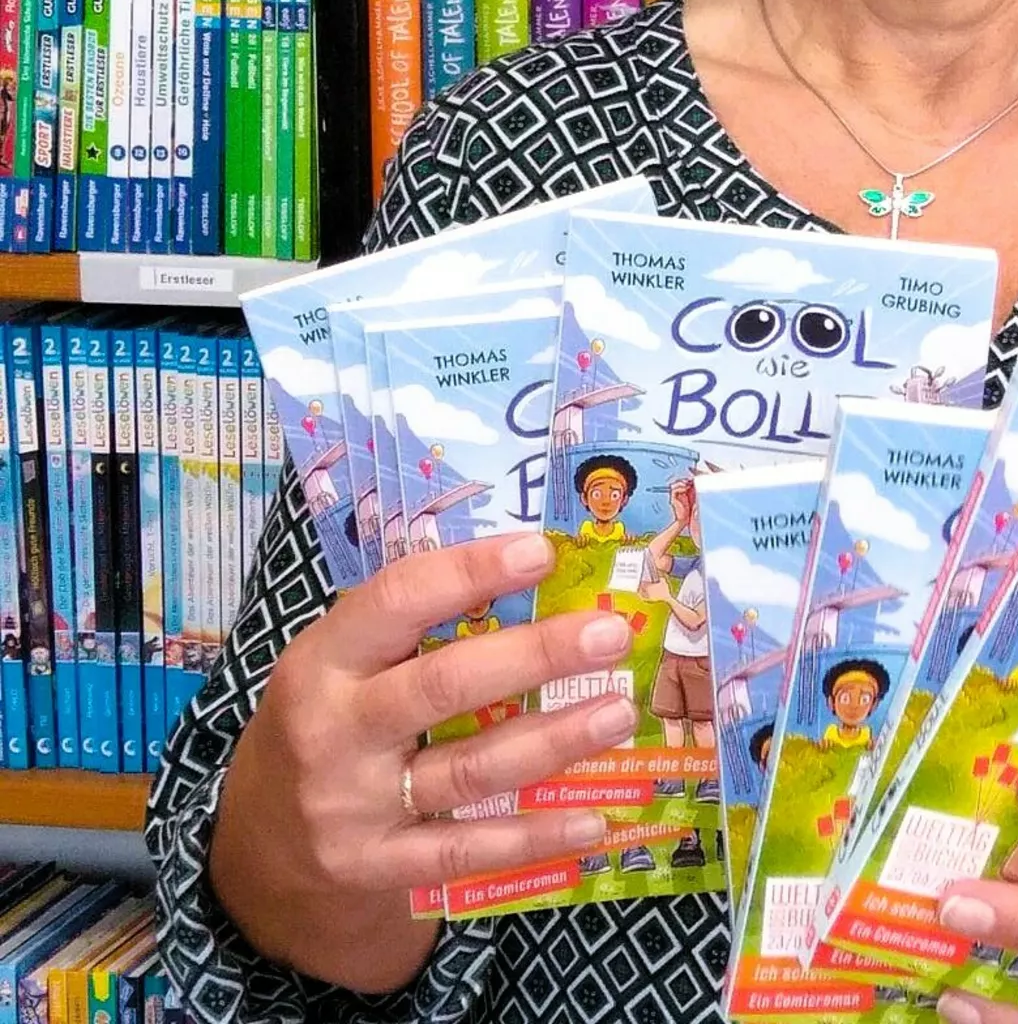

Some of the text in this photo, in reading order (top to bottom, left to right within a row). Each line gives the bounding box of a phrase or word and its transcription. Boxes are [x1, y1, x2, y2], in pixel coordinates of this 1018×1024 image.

[155, 2, 171, 107] Umweltschutz
[177, 19, 191, 106] Gefährliche
[389, 50, 410, 71] OF
[441, 52, 464, 74] OF
[113, 52, 125, 107] Ozeane
[134, 35, 147, 107] Haustiere
[36, 36, 52, 166] SPORT ERSTLESER
[62, 32, 76, 168] HAUSTIERE ERSTLESER
[34, 183, 47, 242] Ravensburger
[59, 179, 72, 238] Ravensburger
[85, 179, 97, 238] Ravensburger
[110, 183, 122, 244] Ravensburger
[612, 252, 685, 271] THOMAS
[160, 274, 215, 286] Erstleser
[611, 272, 685, 291] WINKLER
[899, 276, 943, 296] TIMO
[881, 293, 961, 319] GRUBING
[12, 338, 28, 355] 2
[671, 297, 898, 371] COOL
[222, 350, 236, 366] 2
[434, 348, 508, 371] THOMAS
[757, 353, 810, 379] wie
[436, 368, 511, 390] WINKLER
[46, 372, 62, 445] Leselöwen
[118, 374, 132, 447] Leselöwen
[653, 368, 833, 445] BOLL
[221, 383, 236, 457] Leselöwen
[244, 383, 259, 458] Leselöwen
[887, 449, 965, 471] THOMAS
[884, 471, 962, 492] WINKLER
[749, 511, 818, 534] THOMA
[546, 676, 628, 700] WELTTAG
[621, 757, 679, 773] dir eine
[535, 787, 642, 803] Ein Comicroman
[465, 869, 568, 905] Ein Comicroman
[864, 891, 889, 913] Ich
[849, 921, 957, 957] Ein Comicroman
[748, 991, 861, 1008] Ein Comicroman
